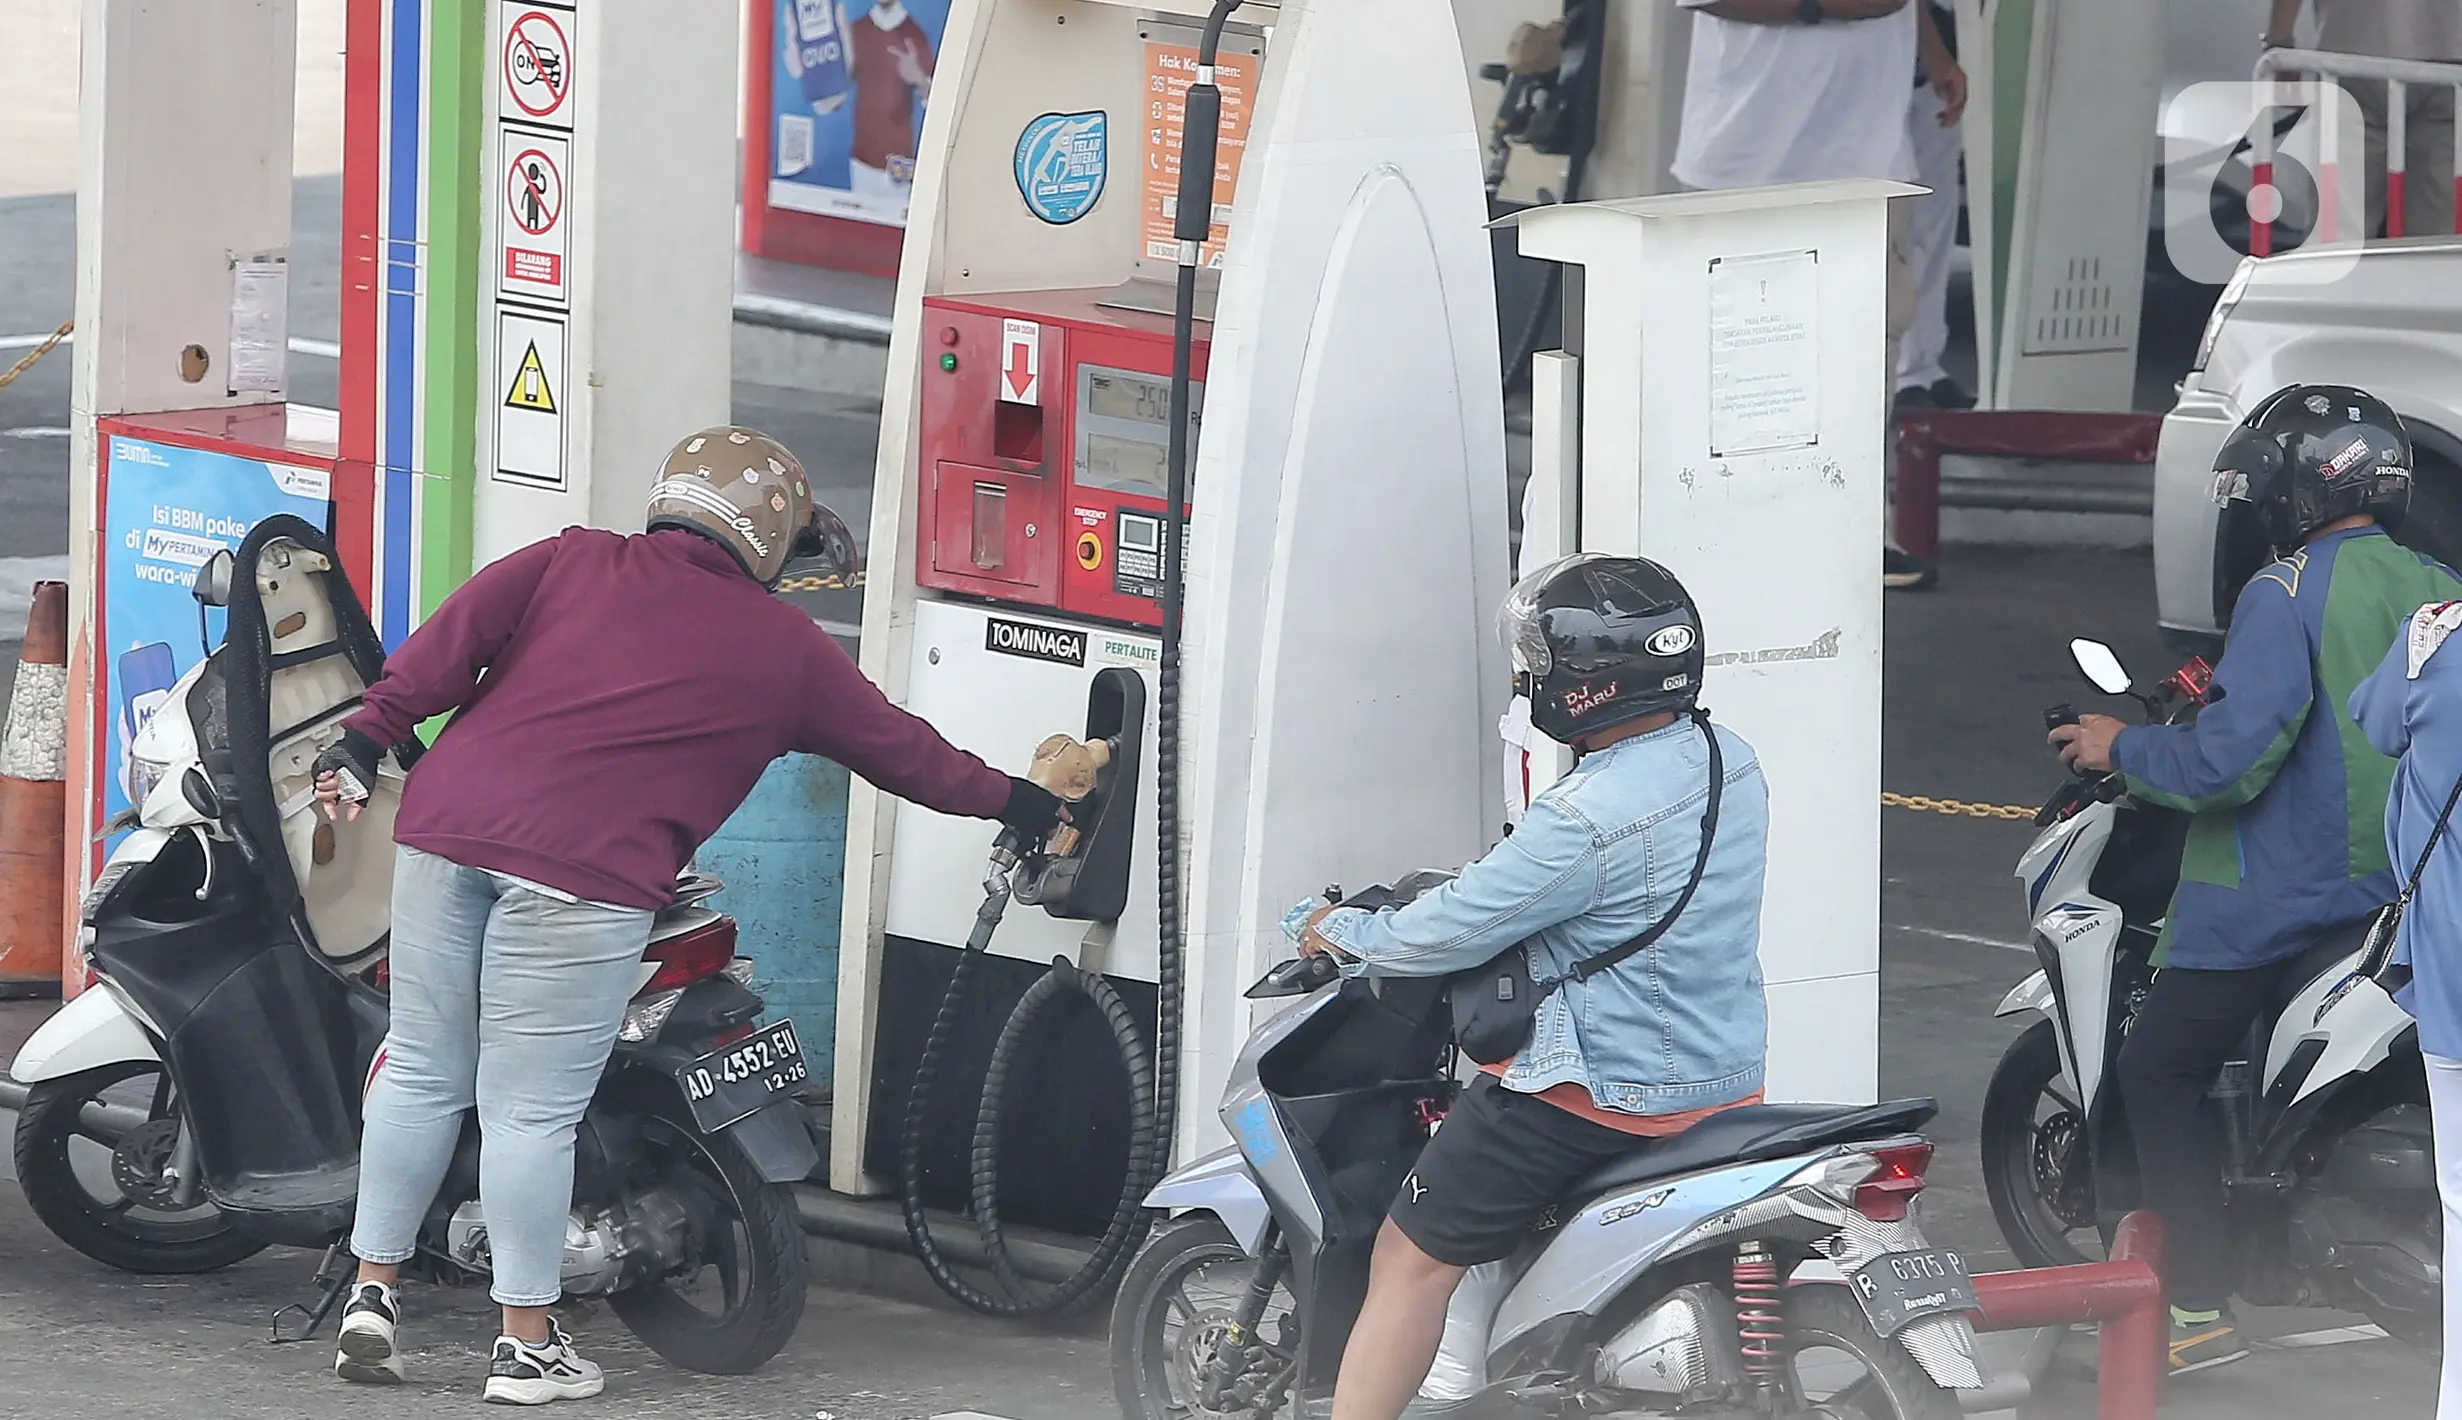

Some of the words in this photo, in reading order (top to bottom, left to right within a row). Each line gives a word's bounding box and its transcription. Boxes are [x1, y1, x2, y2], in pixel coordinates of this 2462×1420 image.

[1159, 54, 1182, 70] Hak
[1183, 57, 1241, 78] Komen:
[2375, 465, 2409, 478] HONDA
[152, 505, 169, 525] Isi
[173, 508, 204, 531] BBM
[206, 514, 246, 539] pake
[125, 529, 141, 549] di
[147, 535, 216, 557] MyPERTAMIN
[730, 517, 769, 557] Classic
[135, 563, 197, 588] wara-wi
[992, 622, 1082, 660] TOMINAGA
[1105, 641, 1158, 661] PERTALITE
[1666, 676, 1686, 688] DOT
[1565, 685, 1589, 706] DJ
[2065, 919, 2100, 943] HONDA
[686, 1067, 714, 1101] AD
[723, 1041, 775, 1083] 4552
[771, 1028, 797, 1059] EU
[1890, 1254, 1945, 1280] 6375
